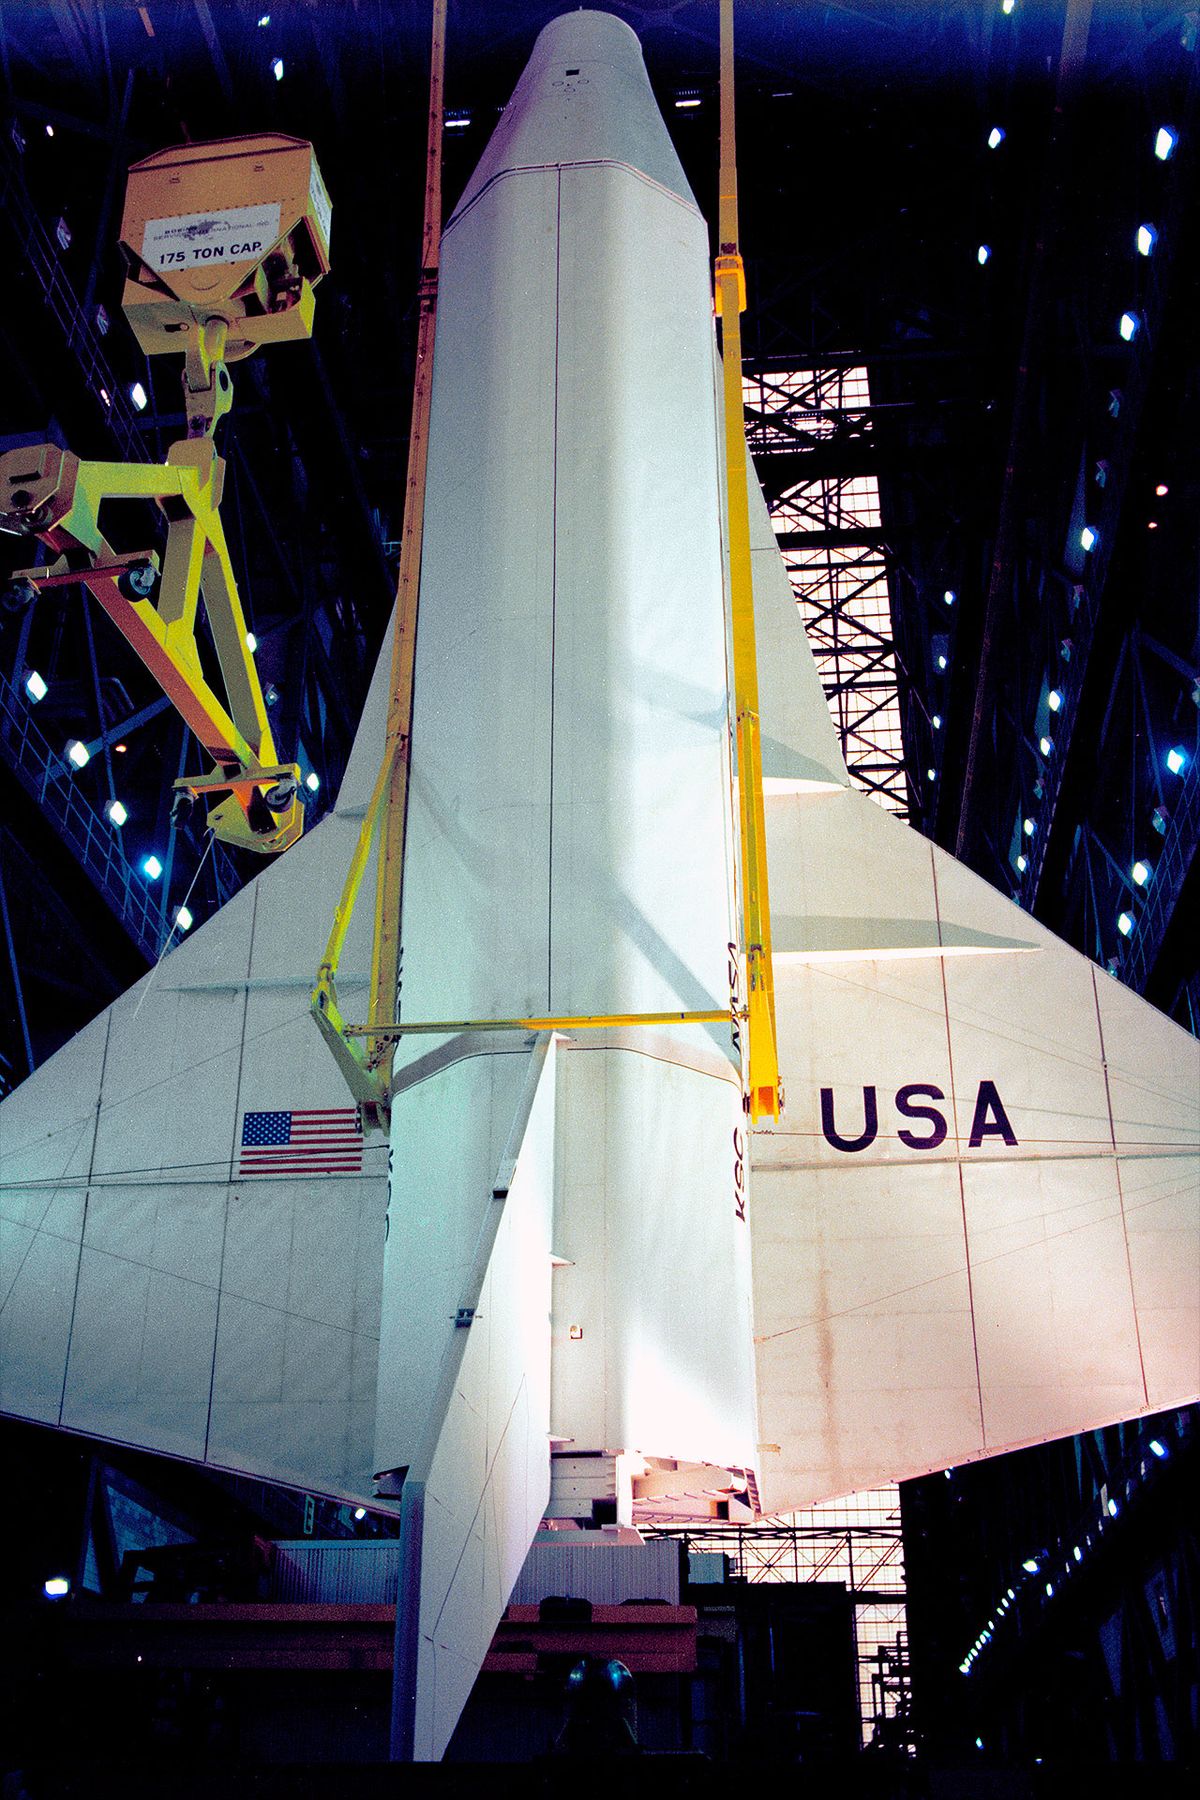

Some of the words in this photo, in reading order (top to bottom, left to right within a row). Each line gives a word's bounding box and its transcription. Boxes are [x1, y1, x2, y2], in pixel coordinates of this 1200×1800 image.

[160, 252, 186, 264] 175
[193, 246, 225, 259] TON
[230, 241, 263, 255] CAP.
[820, 1080, 1019, 1153] USA
[733, 1126, 746, 1222] KSC
